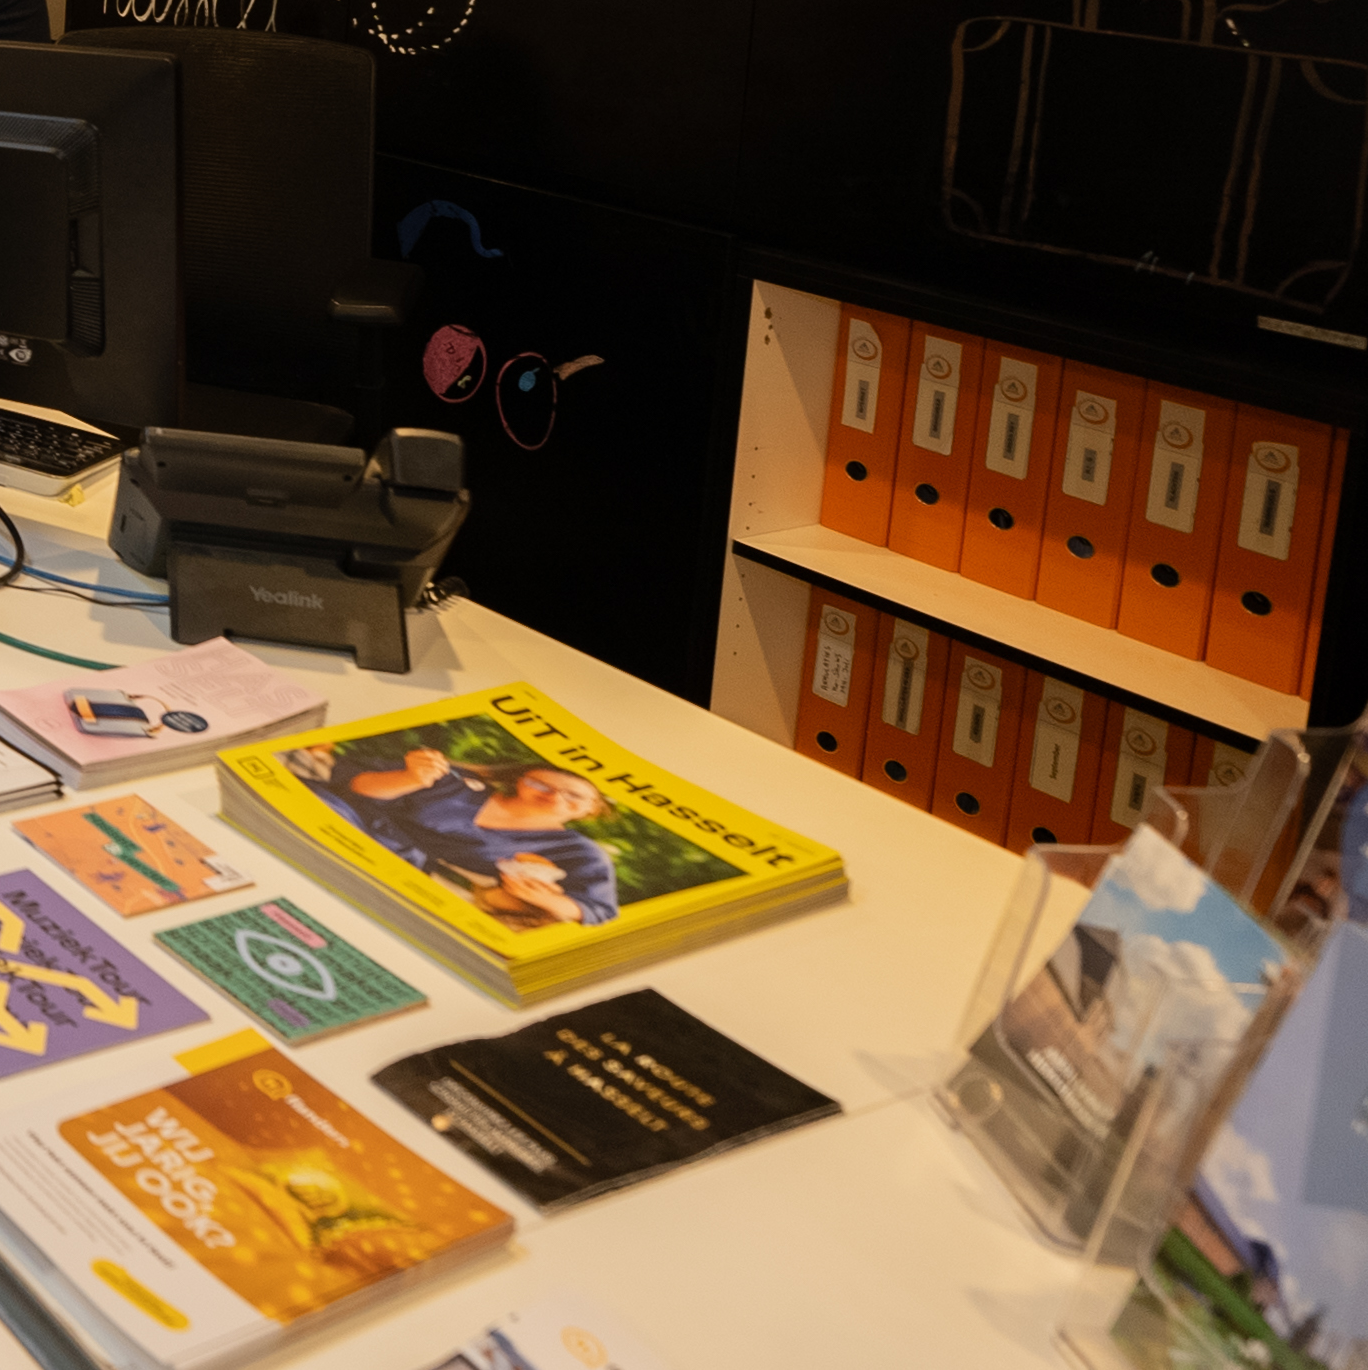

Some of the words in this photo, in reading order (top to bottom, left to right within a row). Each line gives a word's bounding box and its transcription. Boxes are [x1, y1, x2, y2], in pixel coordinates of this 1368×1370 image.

[250, 585, 323, 610] Yealink
[491, 694, 569, 743] UiT
[559, 735, 606, 774] in
[607, 771, 797, 869] Hasselt
[143, 1107, 216, 1163] WIJ
[86, 1130, 140, 1170] JIJ
[133, 1165, 238, 1251] OOK?
